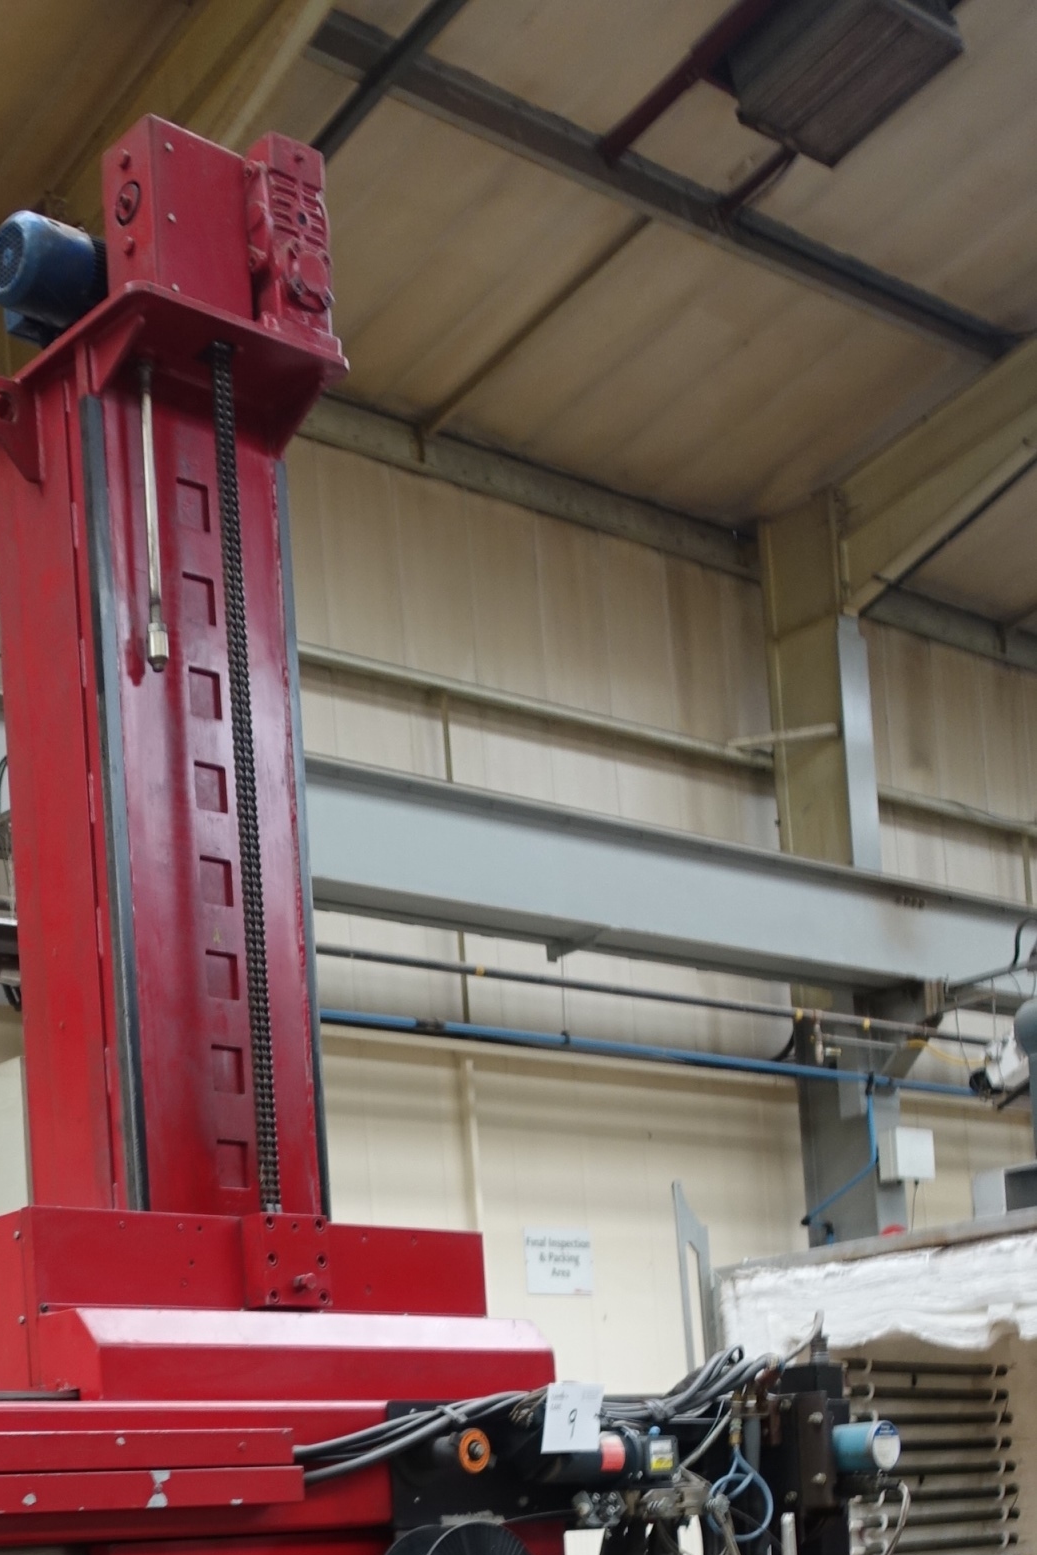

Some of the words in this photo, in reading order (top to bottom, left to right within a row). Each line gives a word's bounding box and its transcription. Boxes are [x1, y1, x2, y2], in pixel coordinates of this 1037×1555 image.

[525, 1236, 546, 1248] Final
[548, 1236, 591, 1251] Inspection
[548, 1251, 581, 1268] Packing
[551, 1267, 571, 1278] Area
[568, 1408, 578, 1440] 9
